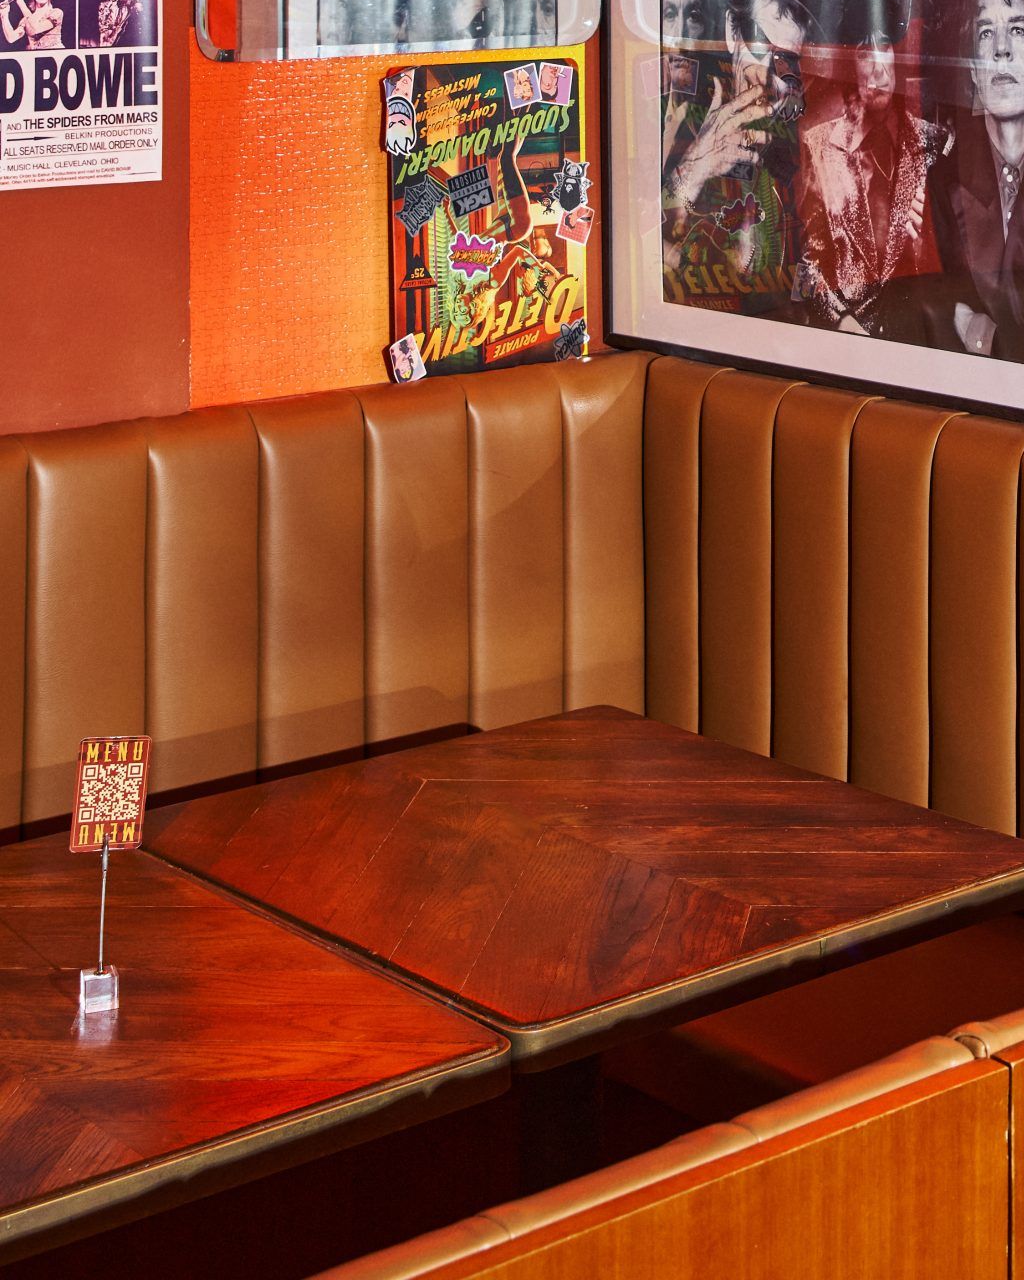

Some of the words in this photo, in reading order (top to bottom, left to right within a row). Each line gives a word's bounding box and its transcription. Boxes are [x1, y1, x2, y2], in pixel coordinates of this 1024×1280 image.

[34, 52, 159, 112] BOWIE
[485, 87, 497, 99] OF
[6, 123, 22, 131] AND
[23, 118, 45, 130] THE
[46, 115, 92, 128] SPIDERS
[94, 113, 124, 126] FROM
[126, 111, 158, 124] MARS
[419, 102, 498, 139] CONFESSIONS
[492, 98, 576, 148] SUDDEN
[64, 131, 93, 140] BELKIN
[95, 127, 153, 139] PRODUCTIONS
[3, 147, 18, 157] ALL
[19, 144, 45, 156] SEATS
[46, 142, 89, 154] RESERVED
[89, 141, 107, 151] MAIL
[108, 139, 136, 150] ORDER
[136, 138, 158, 148] ONLY
[394, 126, 491, 186] DANGER!
[6, 163, 31, 172] MUSIC
[32, 162, 51, 170] HALL
[54, 159, 98, 169] CLEVELAND
[100, 157, 119, 166] OHIO
[455, 188, 491, 214] DGK
[492, 329, 540, 358] PRIVATE
[86, 741, 144, 763] MENU
[78, 821, 136, 845] MENU
